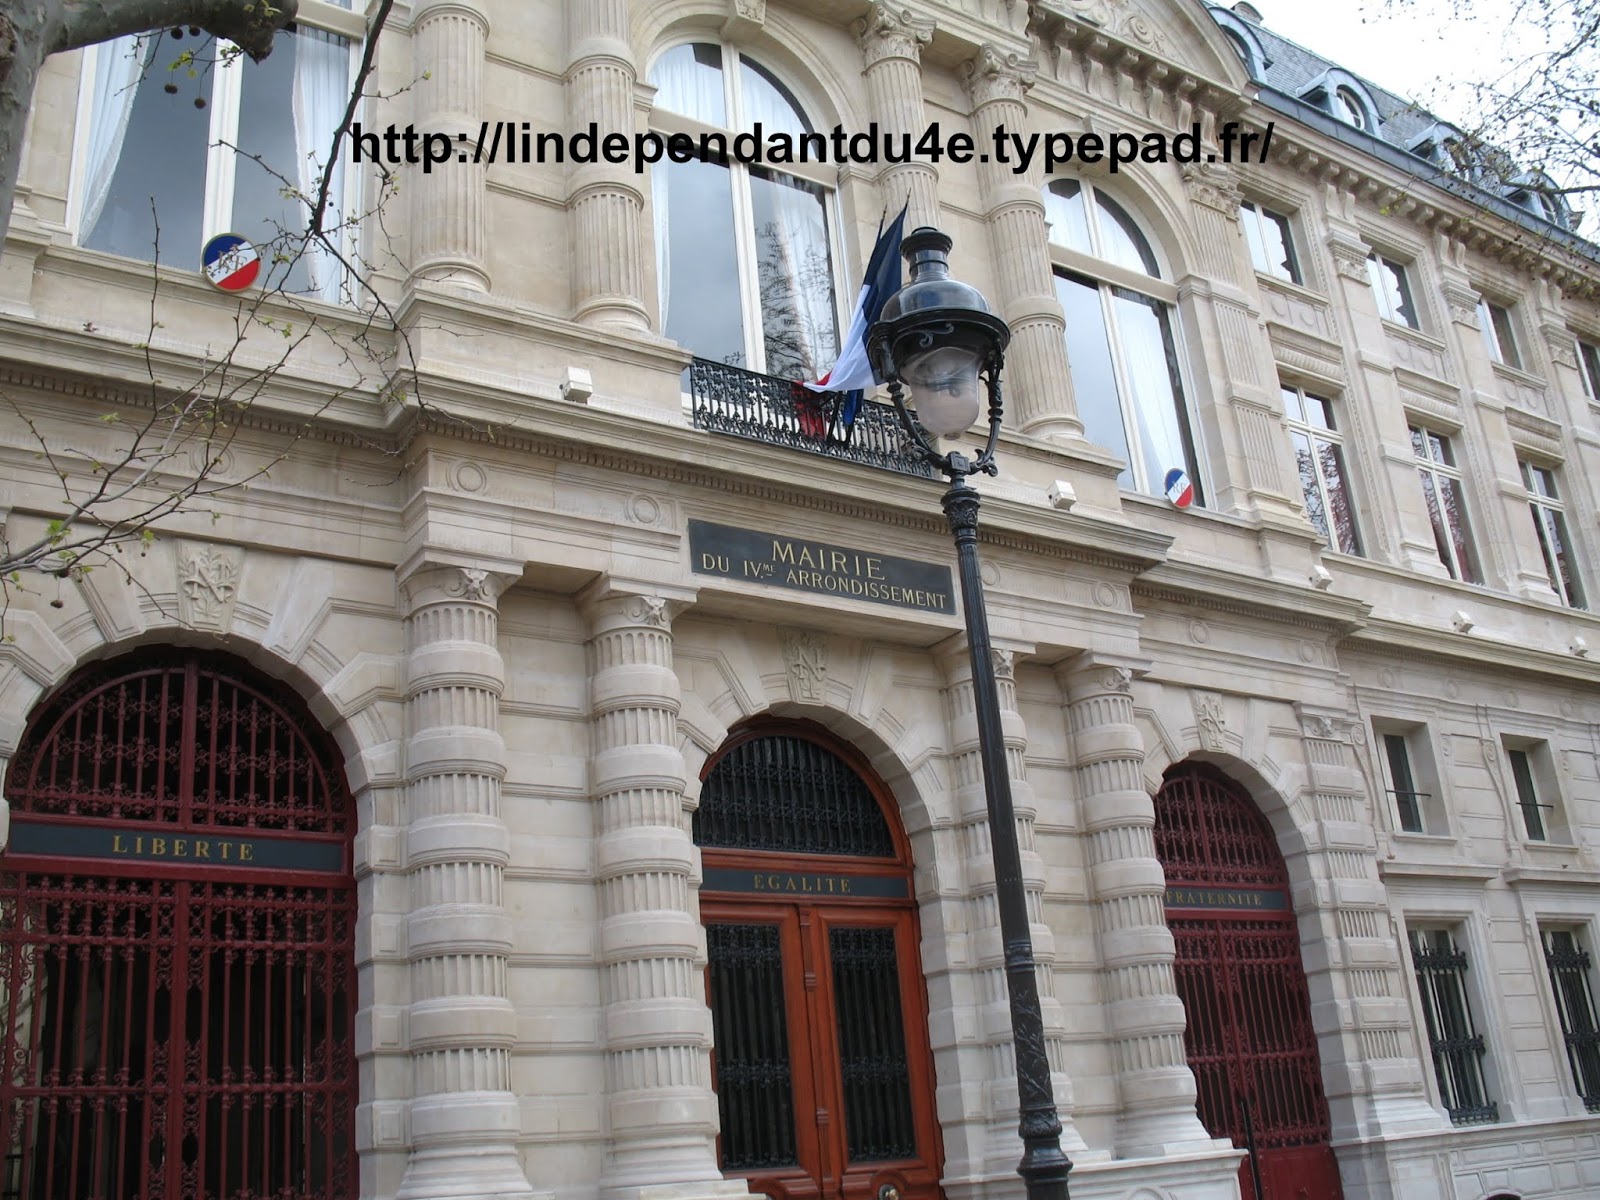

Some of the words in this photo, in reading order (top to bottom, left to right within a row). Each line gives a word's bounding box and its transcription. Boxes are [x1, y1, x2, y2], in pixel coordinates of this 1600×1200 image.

[772, 540, 886, 581] MAIRIE
[702, 553, 730, 573] DU
[786, 569, 946, 609] ARRONDISSEMENT
[112, 835, 253, 861] LIBERTE
[753, 874, 851, 892] EGALITE
[1166, 891, 1262, 906] FRATERNITE
